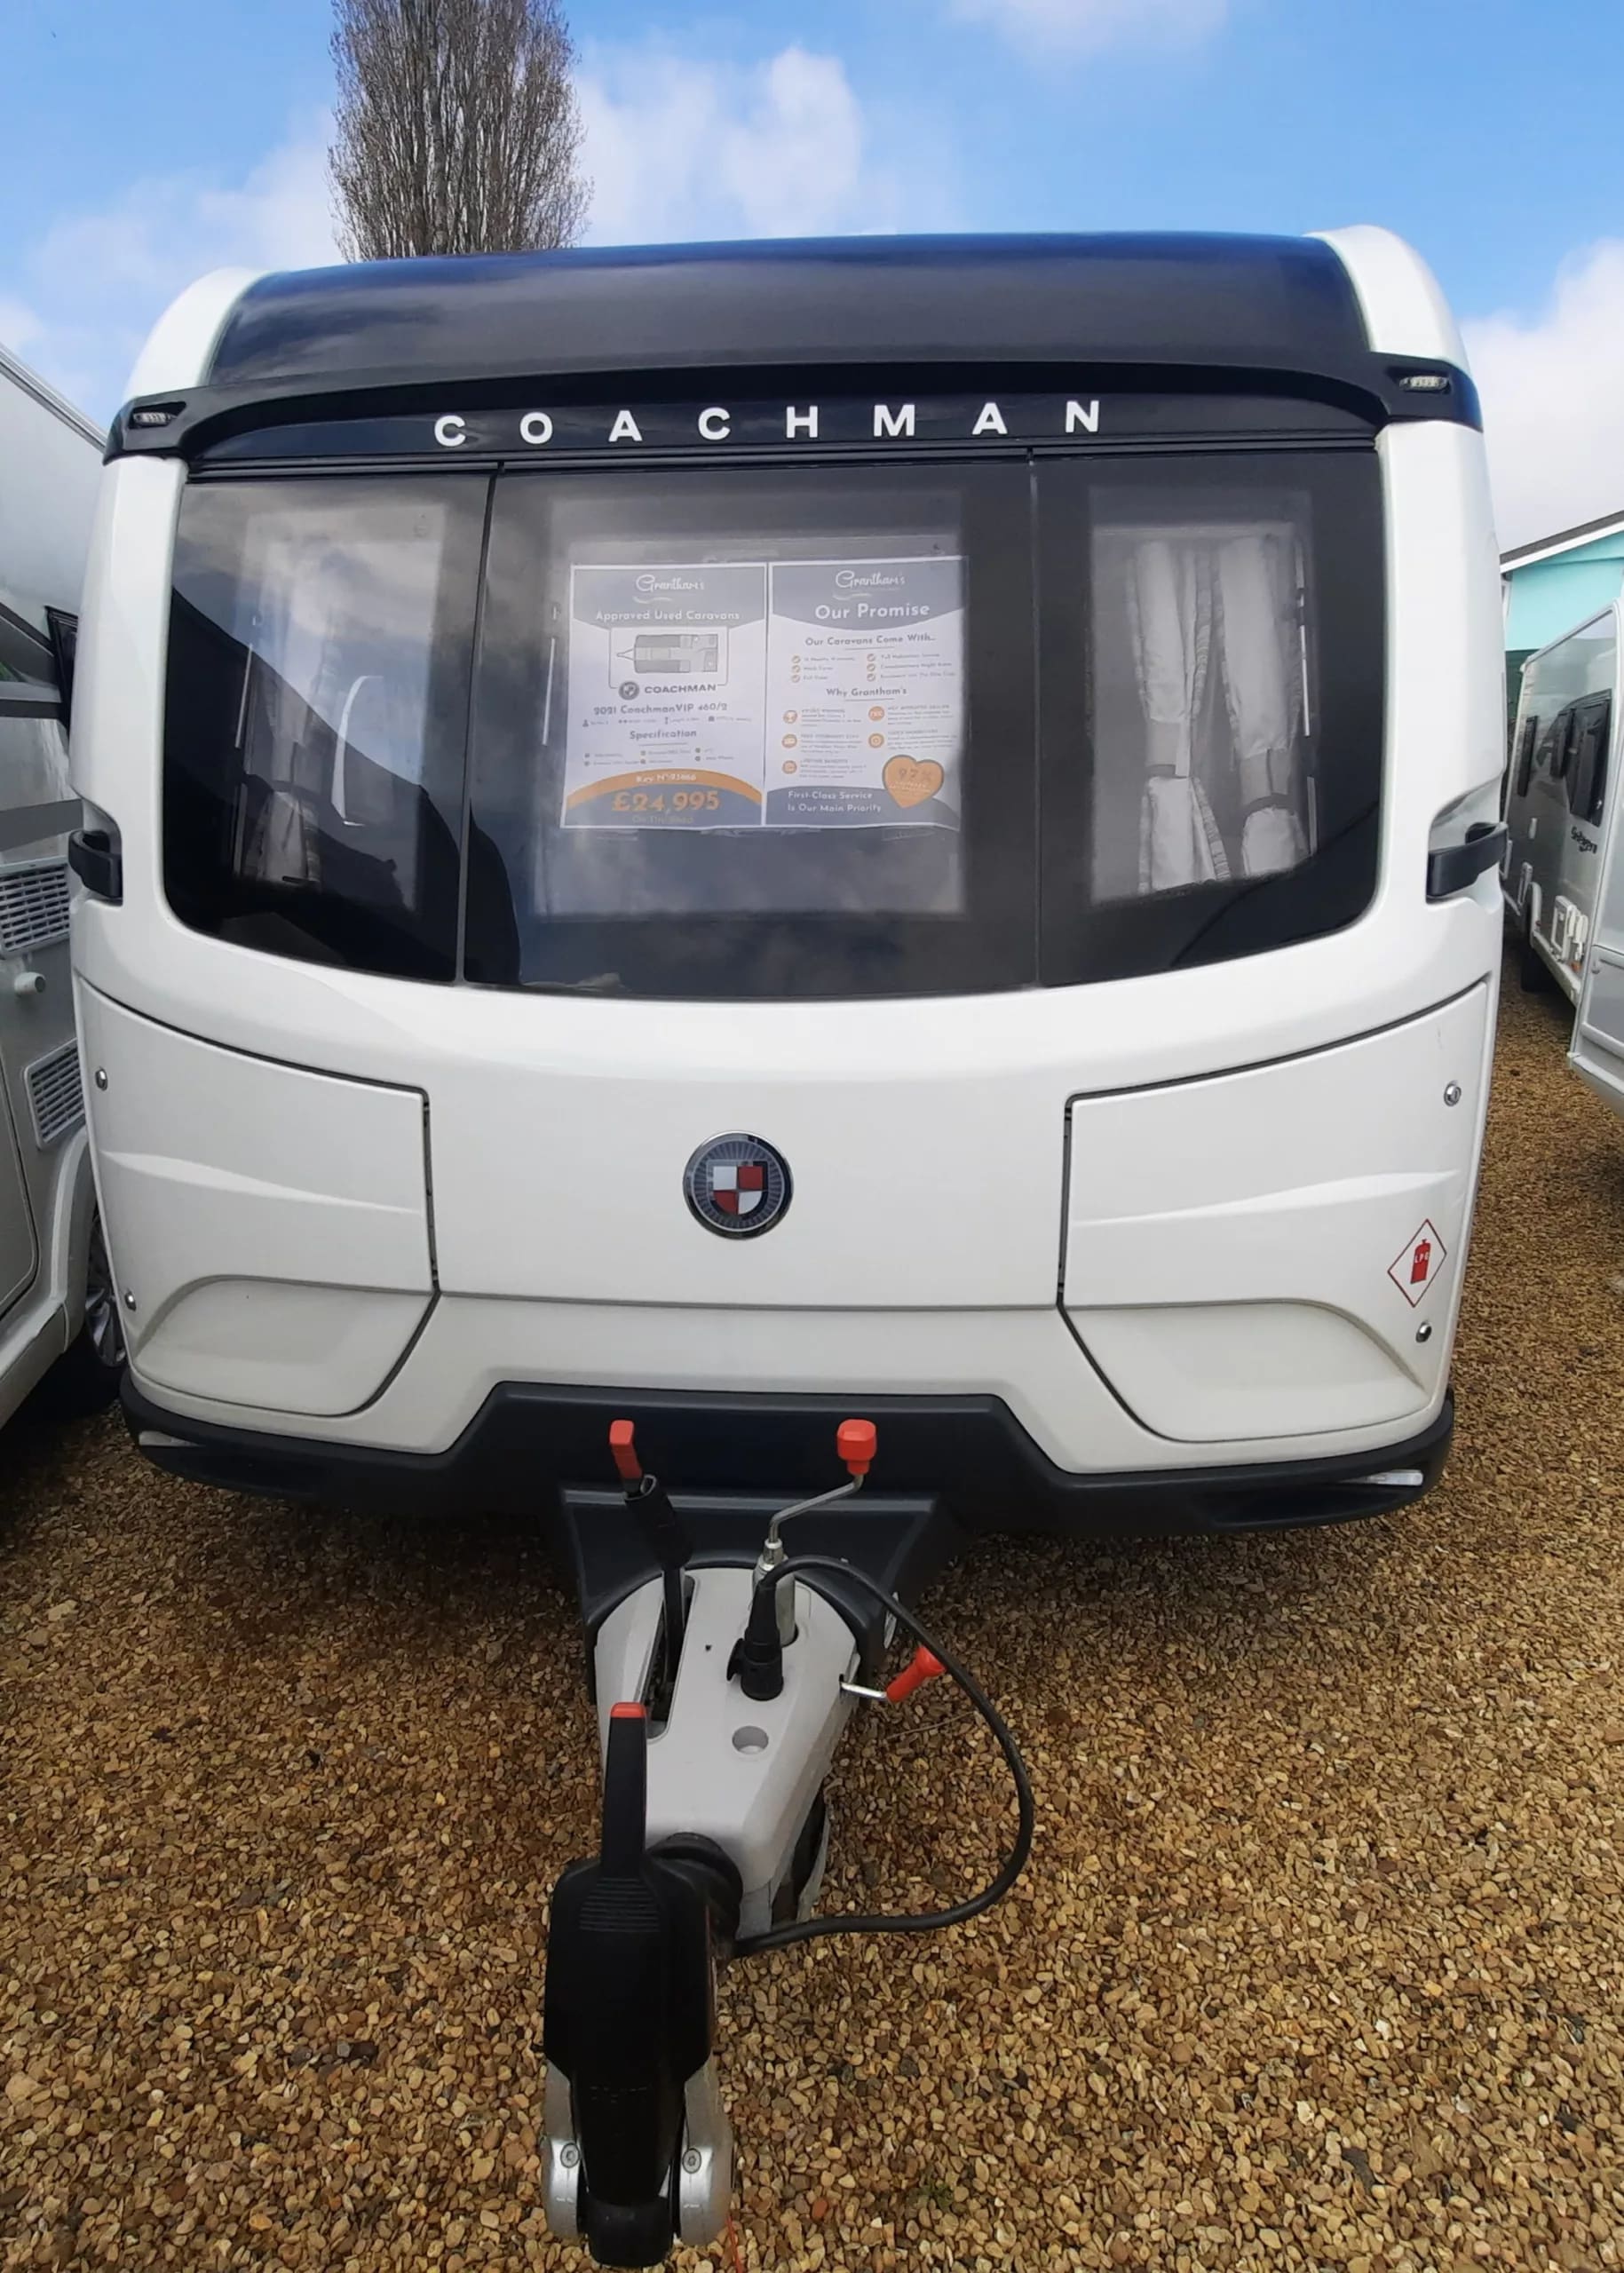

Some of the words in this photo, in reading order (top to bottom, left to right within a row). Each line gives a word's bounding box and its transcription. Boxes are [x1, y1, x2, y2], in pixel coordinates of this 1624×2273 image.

[433, 400, 1101, 447] COACHMAN
[595, 610, 651, 622] Approved
[654, 610, 683, 621] Used
[685, 609, 741, 621] Caravans
[814, 604, 851, 620] Our
[857, 602, 931, 619] Promise
[804, 637, 824, 646] Our
[827, 636, 874, 646] Caravans
[875, 634, 904, 645] Come
[644, 684, 717, 695] COACHMAN
[826, 687, 848, 699] Why
[850, 685, 907, 698] Grantham's
[629, 729, 698, 741] Specification
[611, 788, 721, 814] £24,995
[839, 790, 873, 800] Service
[798, 804, 817, 812] Our
[819, 804, 845, 812] Main
[846, 803, 882, 813] Priority
